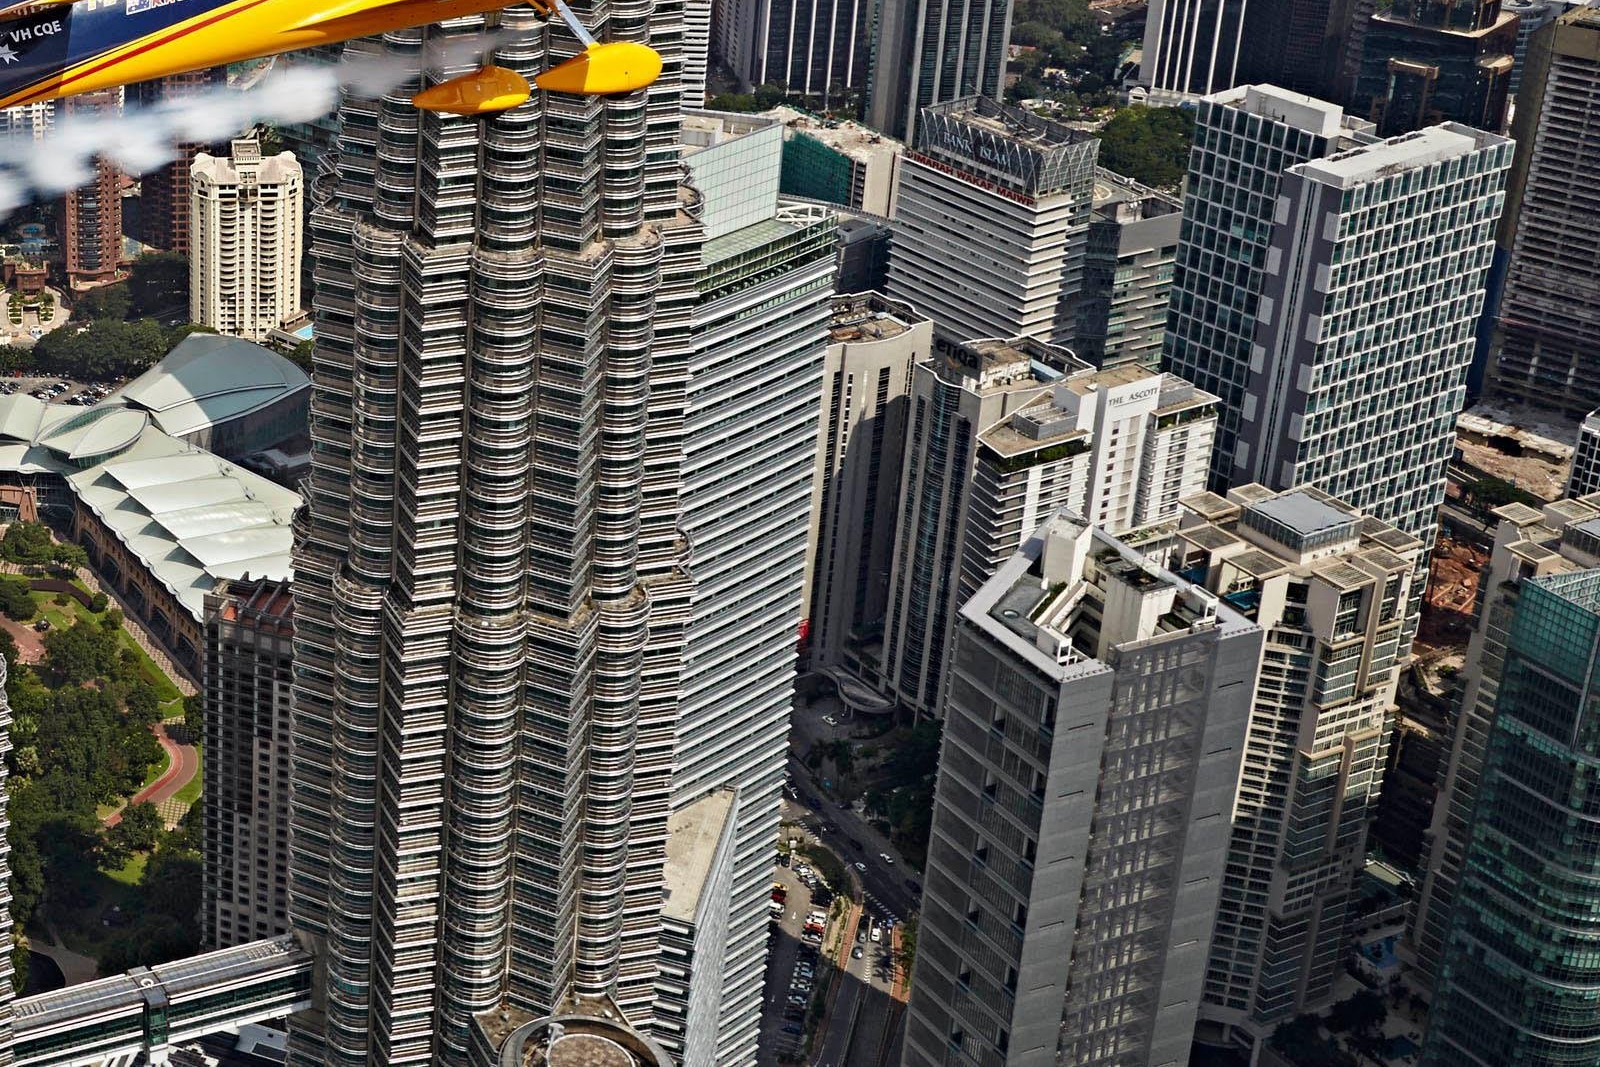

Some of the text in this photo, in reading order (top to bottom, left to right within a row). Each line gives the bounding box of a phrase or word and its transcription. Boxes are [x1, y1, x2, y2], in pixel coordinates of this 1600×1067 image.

[10, 20, 62, 42] VH CQE
[943, 132, 1007, 166] BANK ISLAM
[956, 169, 994, 193] WAKAF
[1108, 387, 1158, 406] THE ASCOTT
